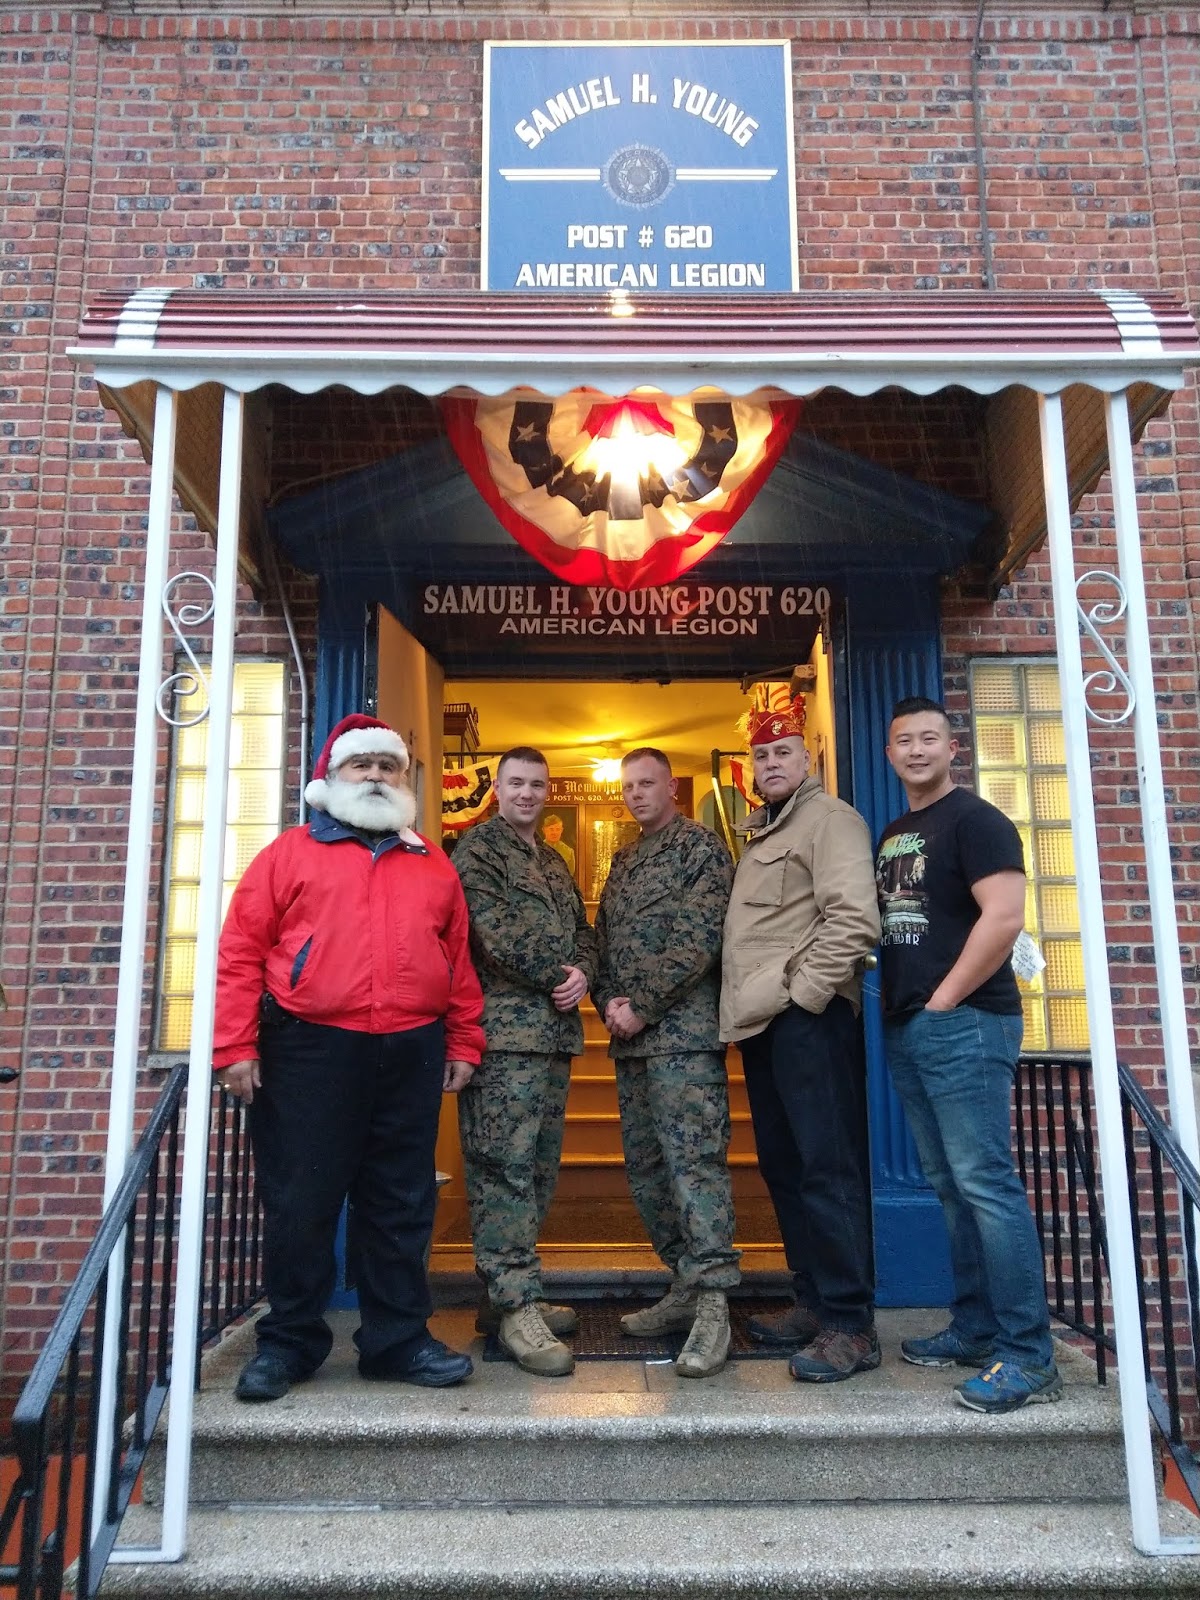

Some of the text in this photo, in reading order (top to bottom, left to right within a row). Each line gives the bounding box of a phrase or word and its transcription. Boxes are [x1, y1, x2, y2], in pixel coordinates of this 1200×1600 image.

[514, 73, 760, 149] SAMUEL H. YOUNG
[567, 225, 713, 248] POST # 620
[516, 263, 765, 287] AMERICAN LEGION
[424, 585, 831, 615] SAMUEL H. YOUNG POST 620
[499, 618, 758, 635] AMERICAN LEGION
